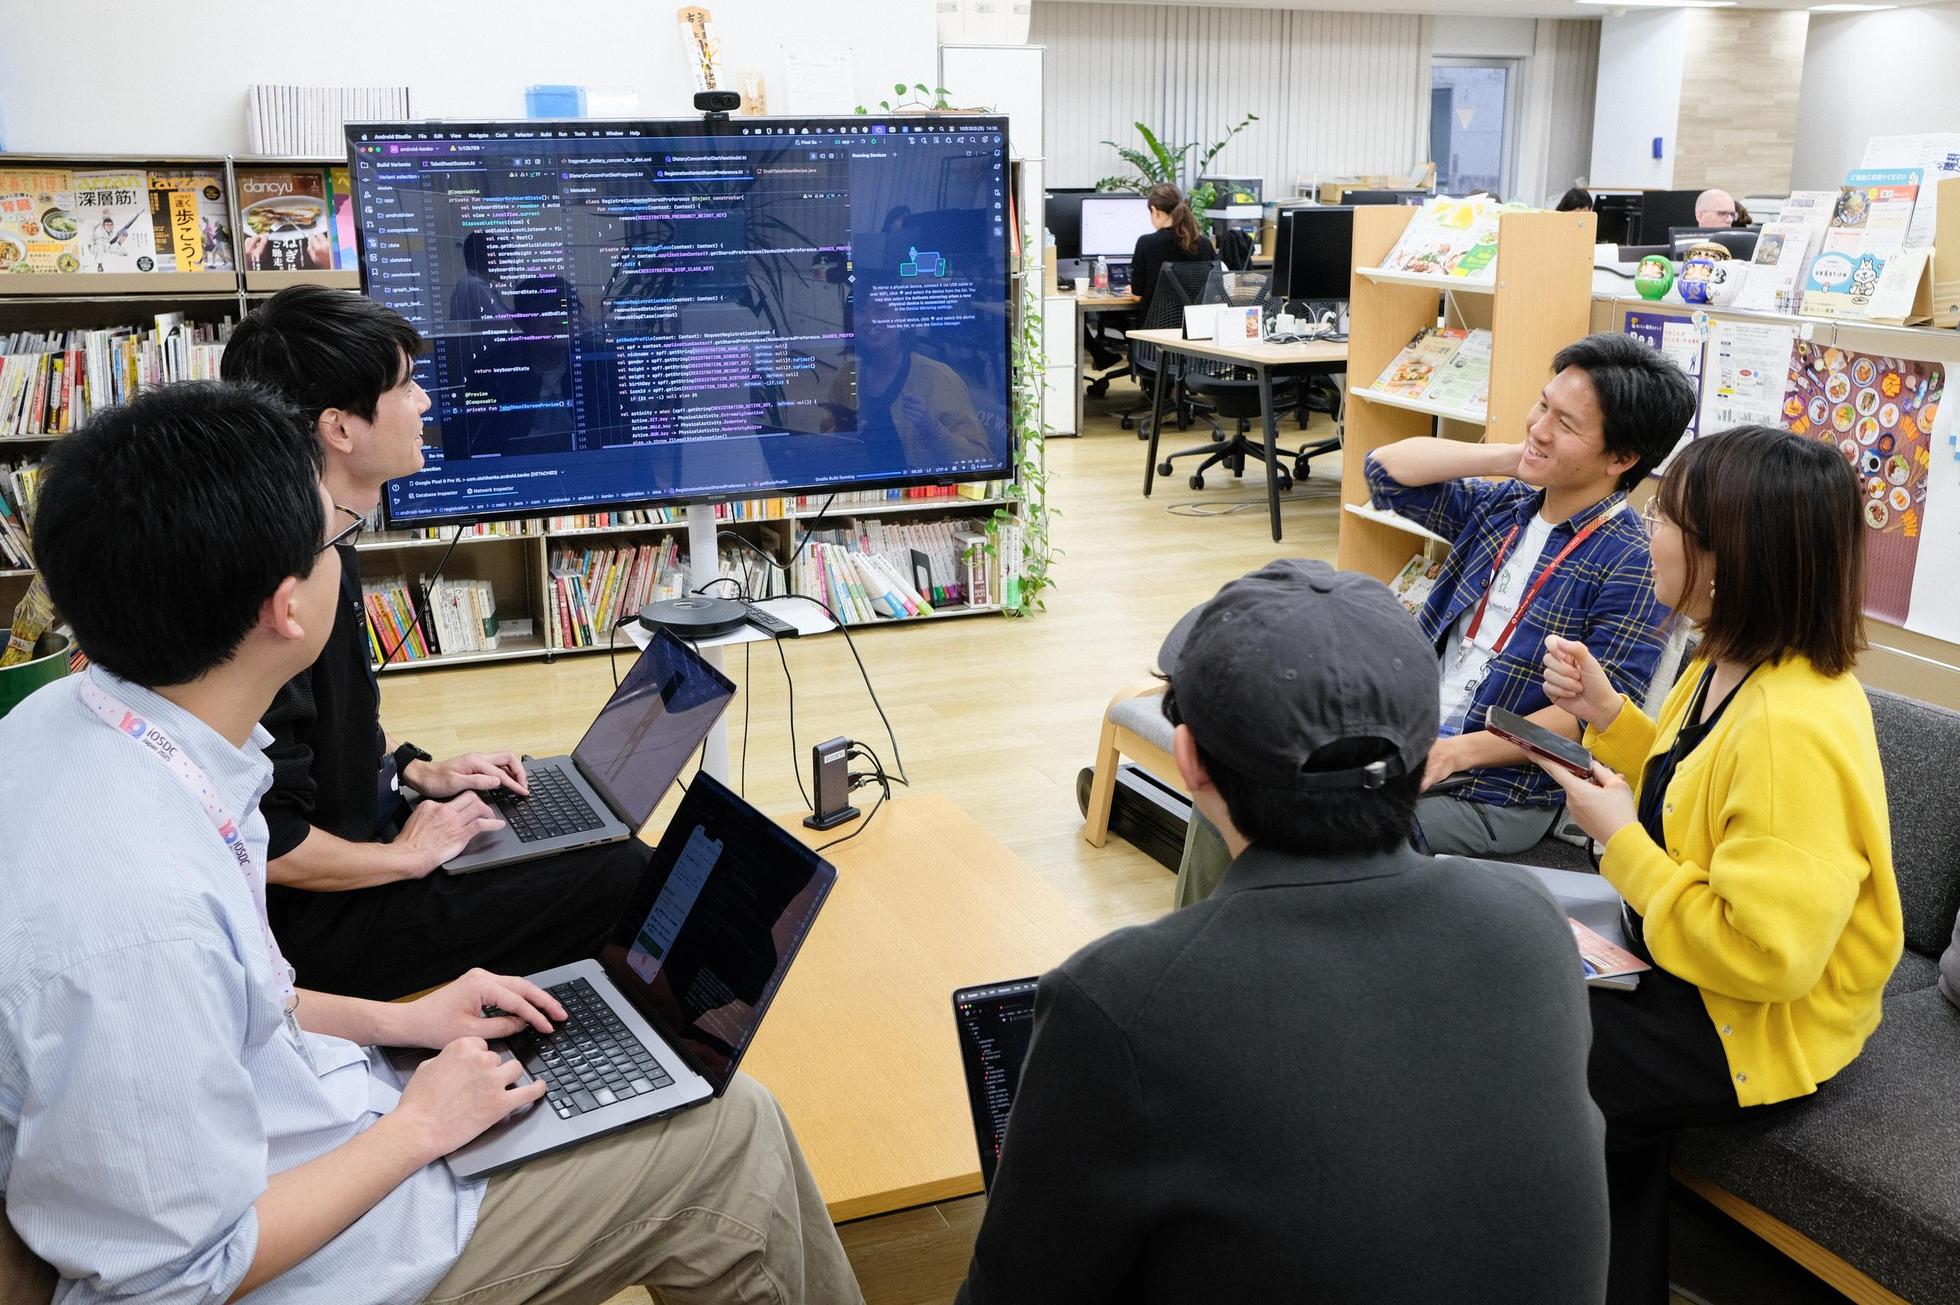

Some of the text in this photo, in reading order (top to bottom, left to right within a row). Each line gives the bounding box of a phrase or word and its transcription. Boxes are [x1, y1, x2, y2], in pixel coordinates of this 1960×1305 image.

[79, 190, 137, 206] 深層筋!
[243, 178, 293, 196] dancyu
[176, 209, 196, 272] 歩こう!
[147, 727, 178, 757] iOSDC
[232, 839, 250, 866] iOSDC
